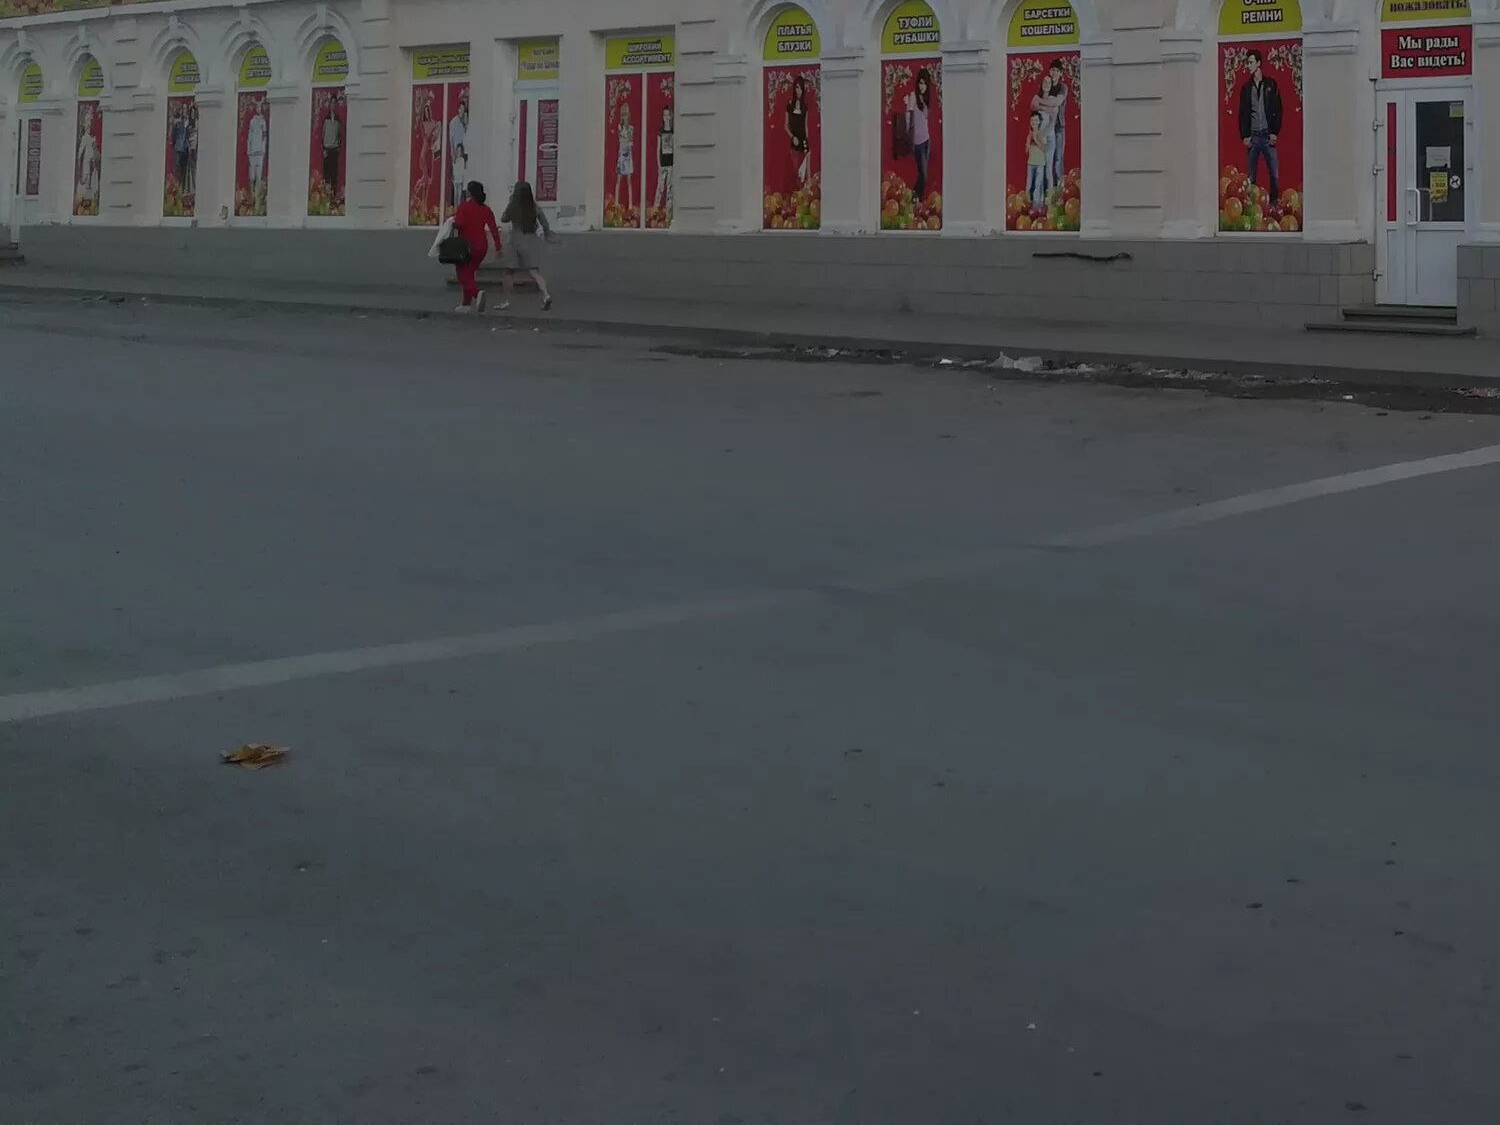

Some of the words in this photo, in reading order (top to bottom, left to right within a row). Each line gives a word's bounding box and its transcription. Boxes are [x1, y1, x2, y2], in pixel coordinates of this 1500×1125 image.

[1024, 7, 1071, 20] БАРСЕТКИ
[1242, 9, 1282, 23] РЕМНИ
[898, 15, 933, 28] ТУФЛИ
[777, 24, 812, 37] ПЛАТЬЯ
[1021, 23, 1074, 36] КОШЕЛЬКИ
[894, 31, 939, 44] РУБАШКИ
[1398, 36, 1422, 50] Мы
[1426, 36, 1459, 51] рады
[778, 40, 812, 52] БЛУЗКИ
[1391, 54, 1414, 68] Вас
[1417, 51, 1466, 67] видеть!
